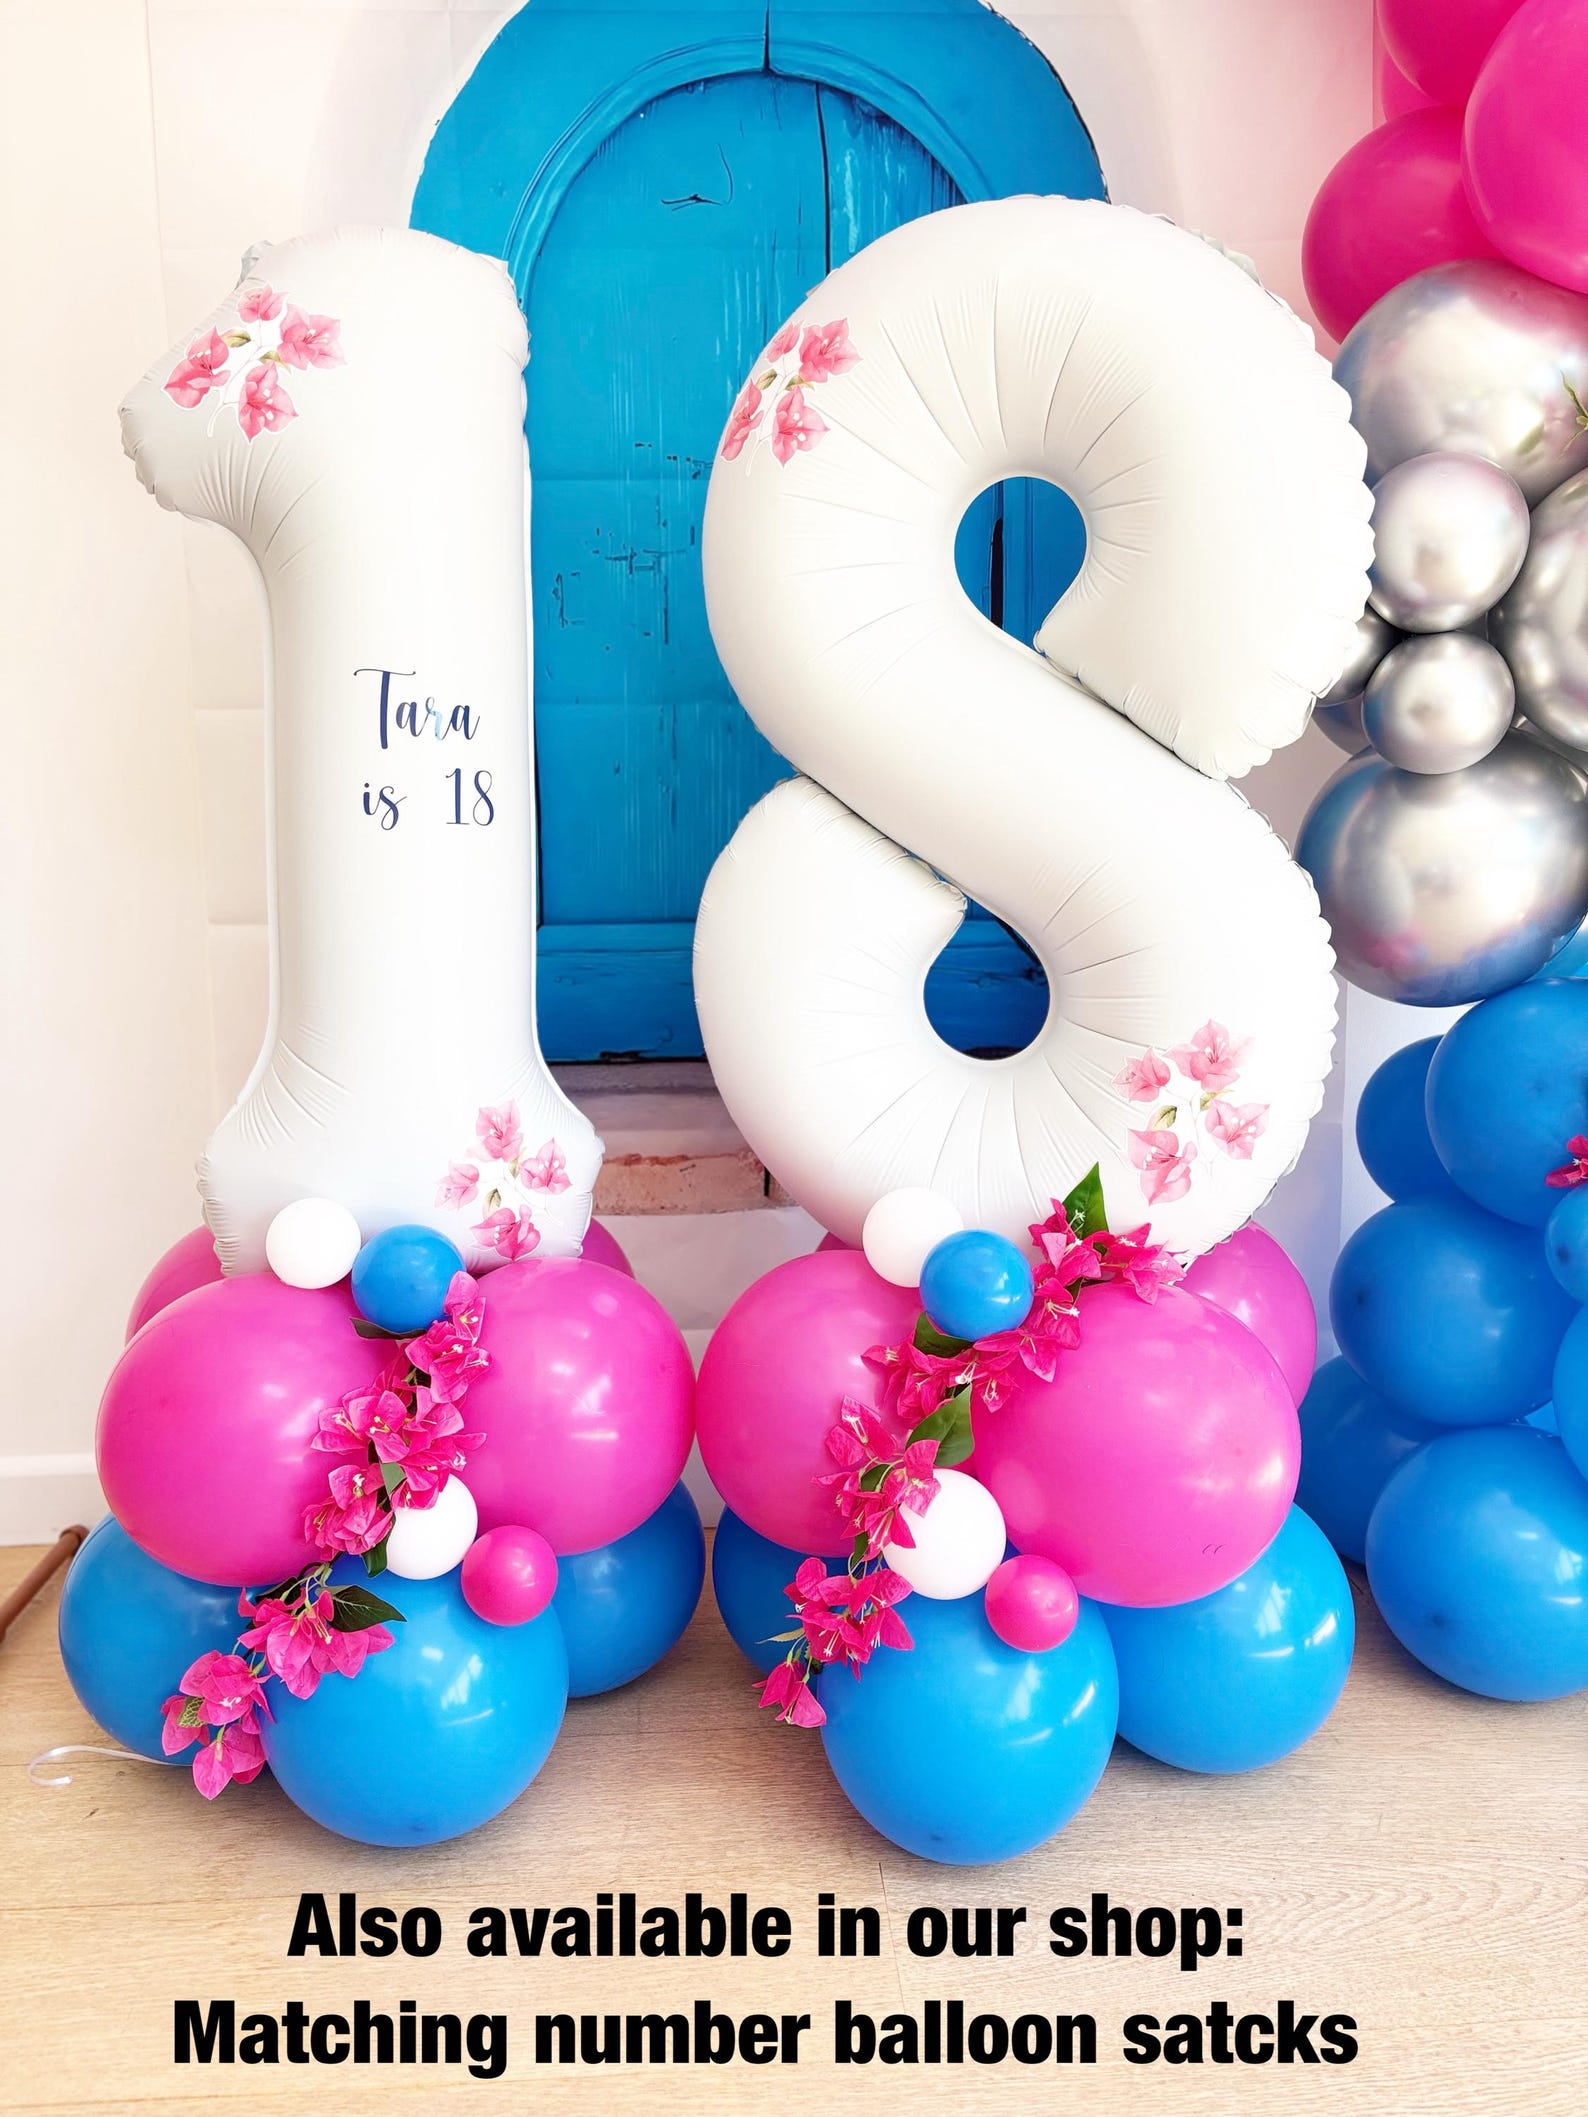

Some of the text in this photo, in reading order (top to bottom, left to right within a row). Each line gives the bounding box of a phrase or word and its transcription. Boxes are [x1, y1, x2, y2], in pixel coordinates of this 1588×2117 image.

[353, 668, 481, 750] Tara
[362, 767, 495, 831] is 18
